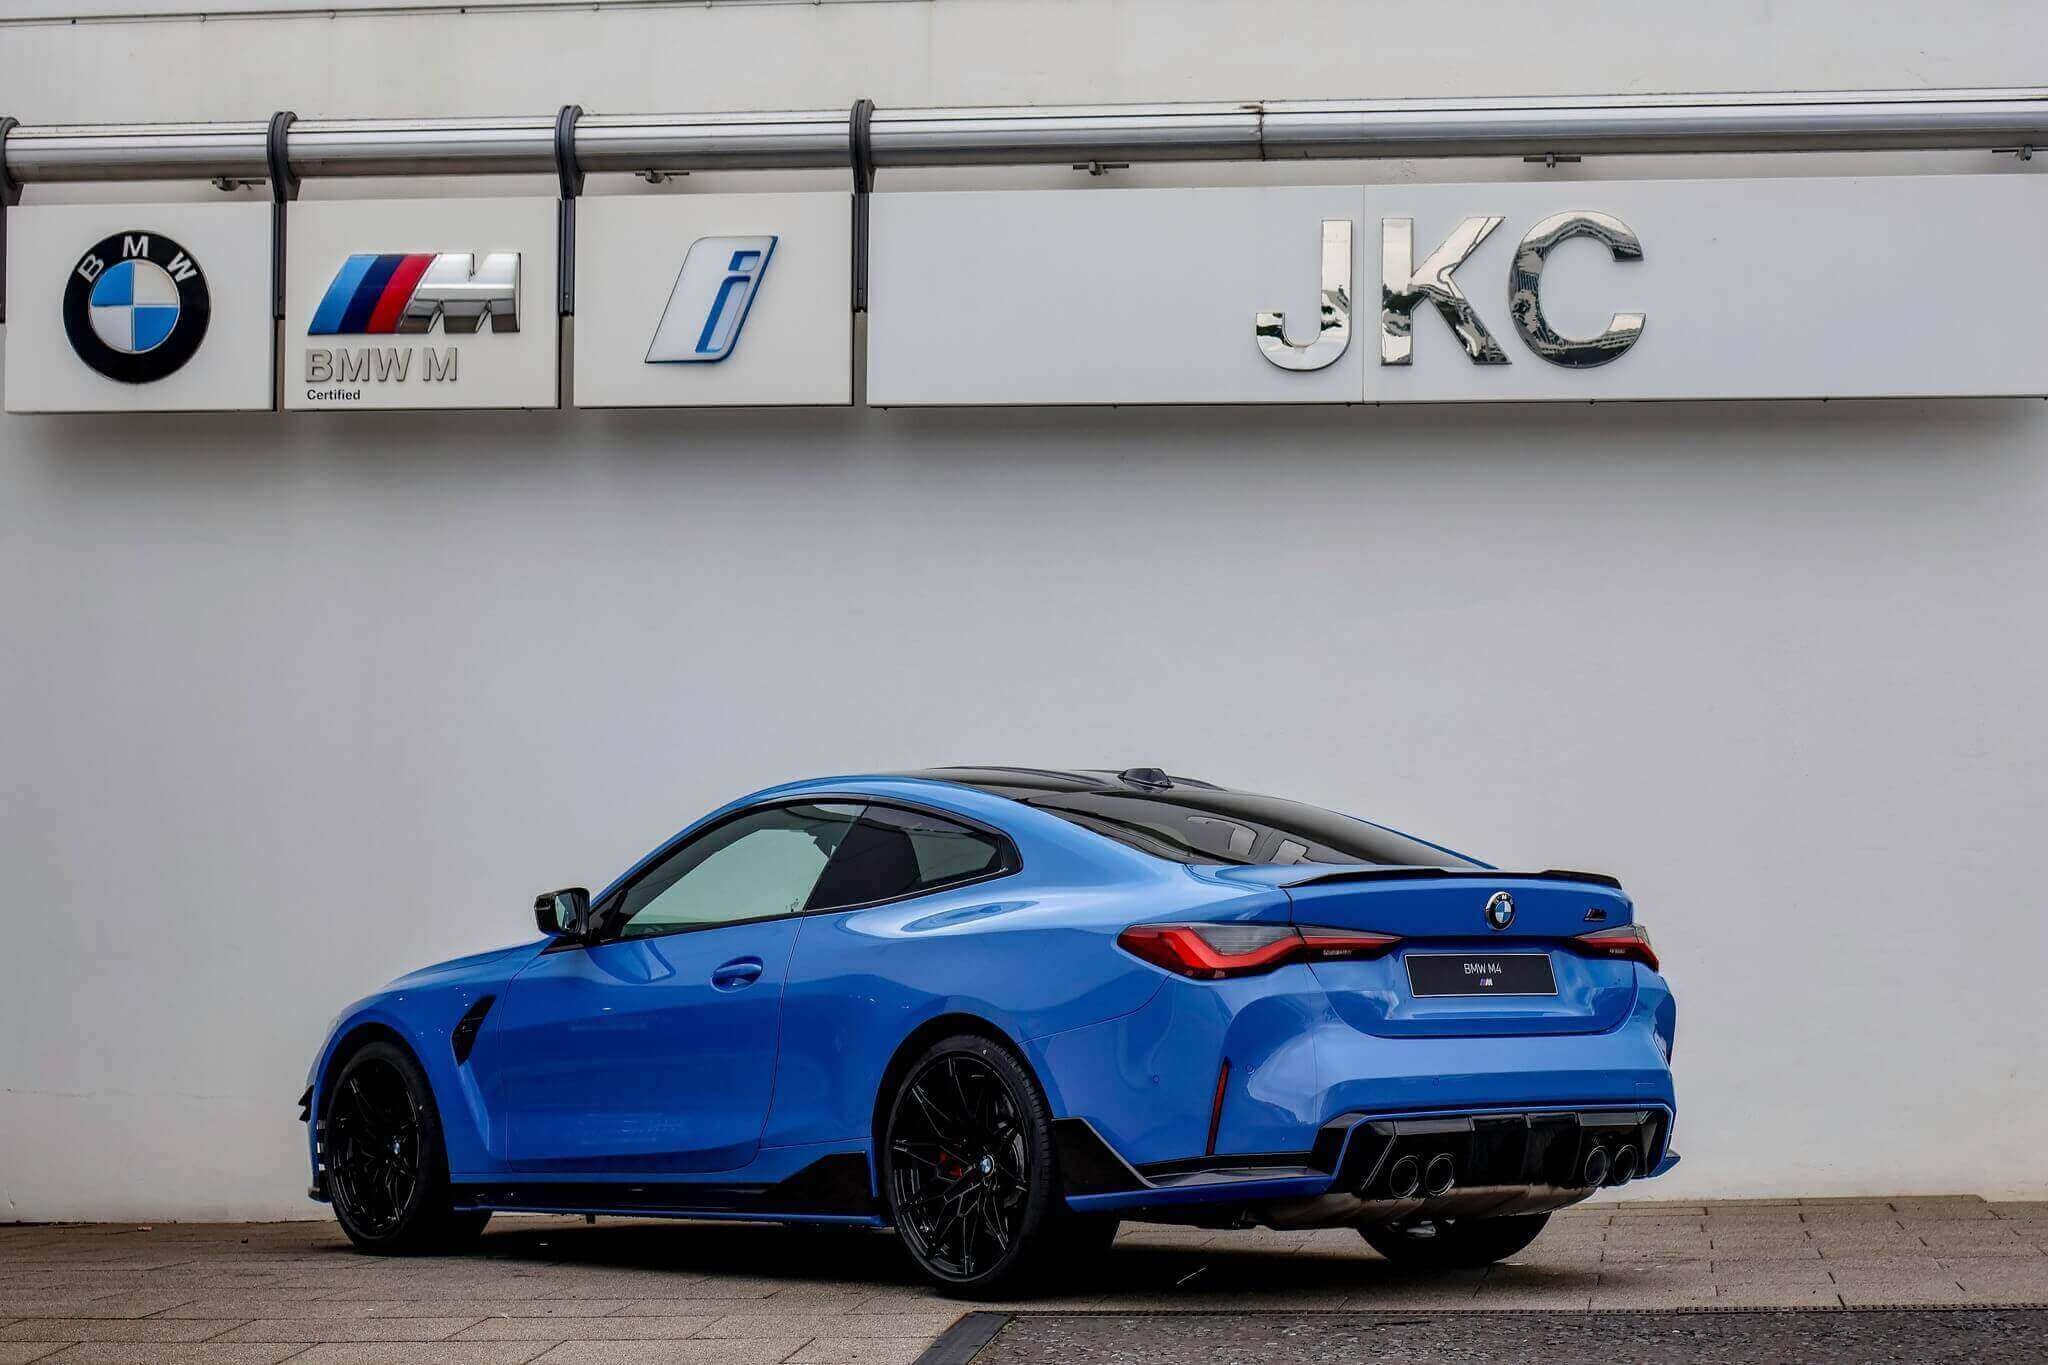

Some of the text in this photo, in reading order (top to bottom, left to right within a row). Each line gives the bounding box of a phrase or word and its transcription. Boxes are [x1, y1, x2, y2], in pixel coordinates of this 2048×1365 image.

[77, 235, 198, 283] BMW
[1255, 210, 1647, 372] JKC
[305, 347, 458, 383] BMW M
[306, 389, 361, 401] Certified
[1463, 962, 1502, 974] BMW M4
